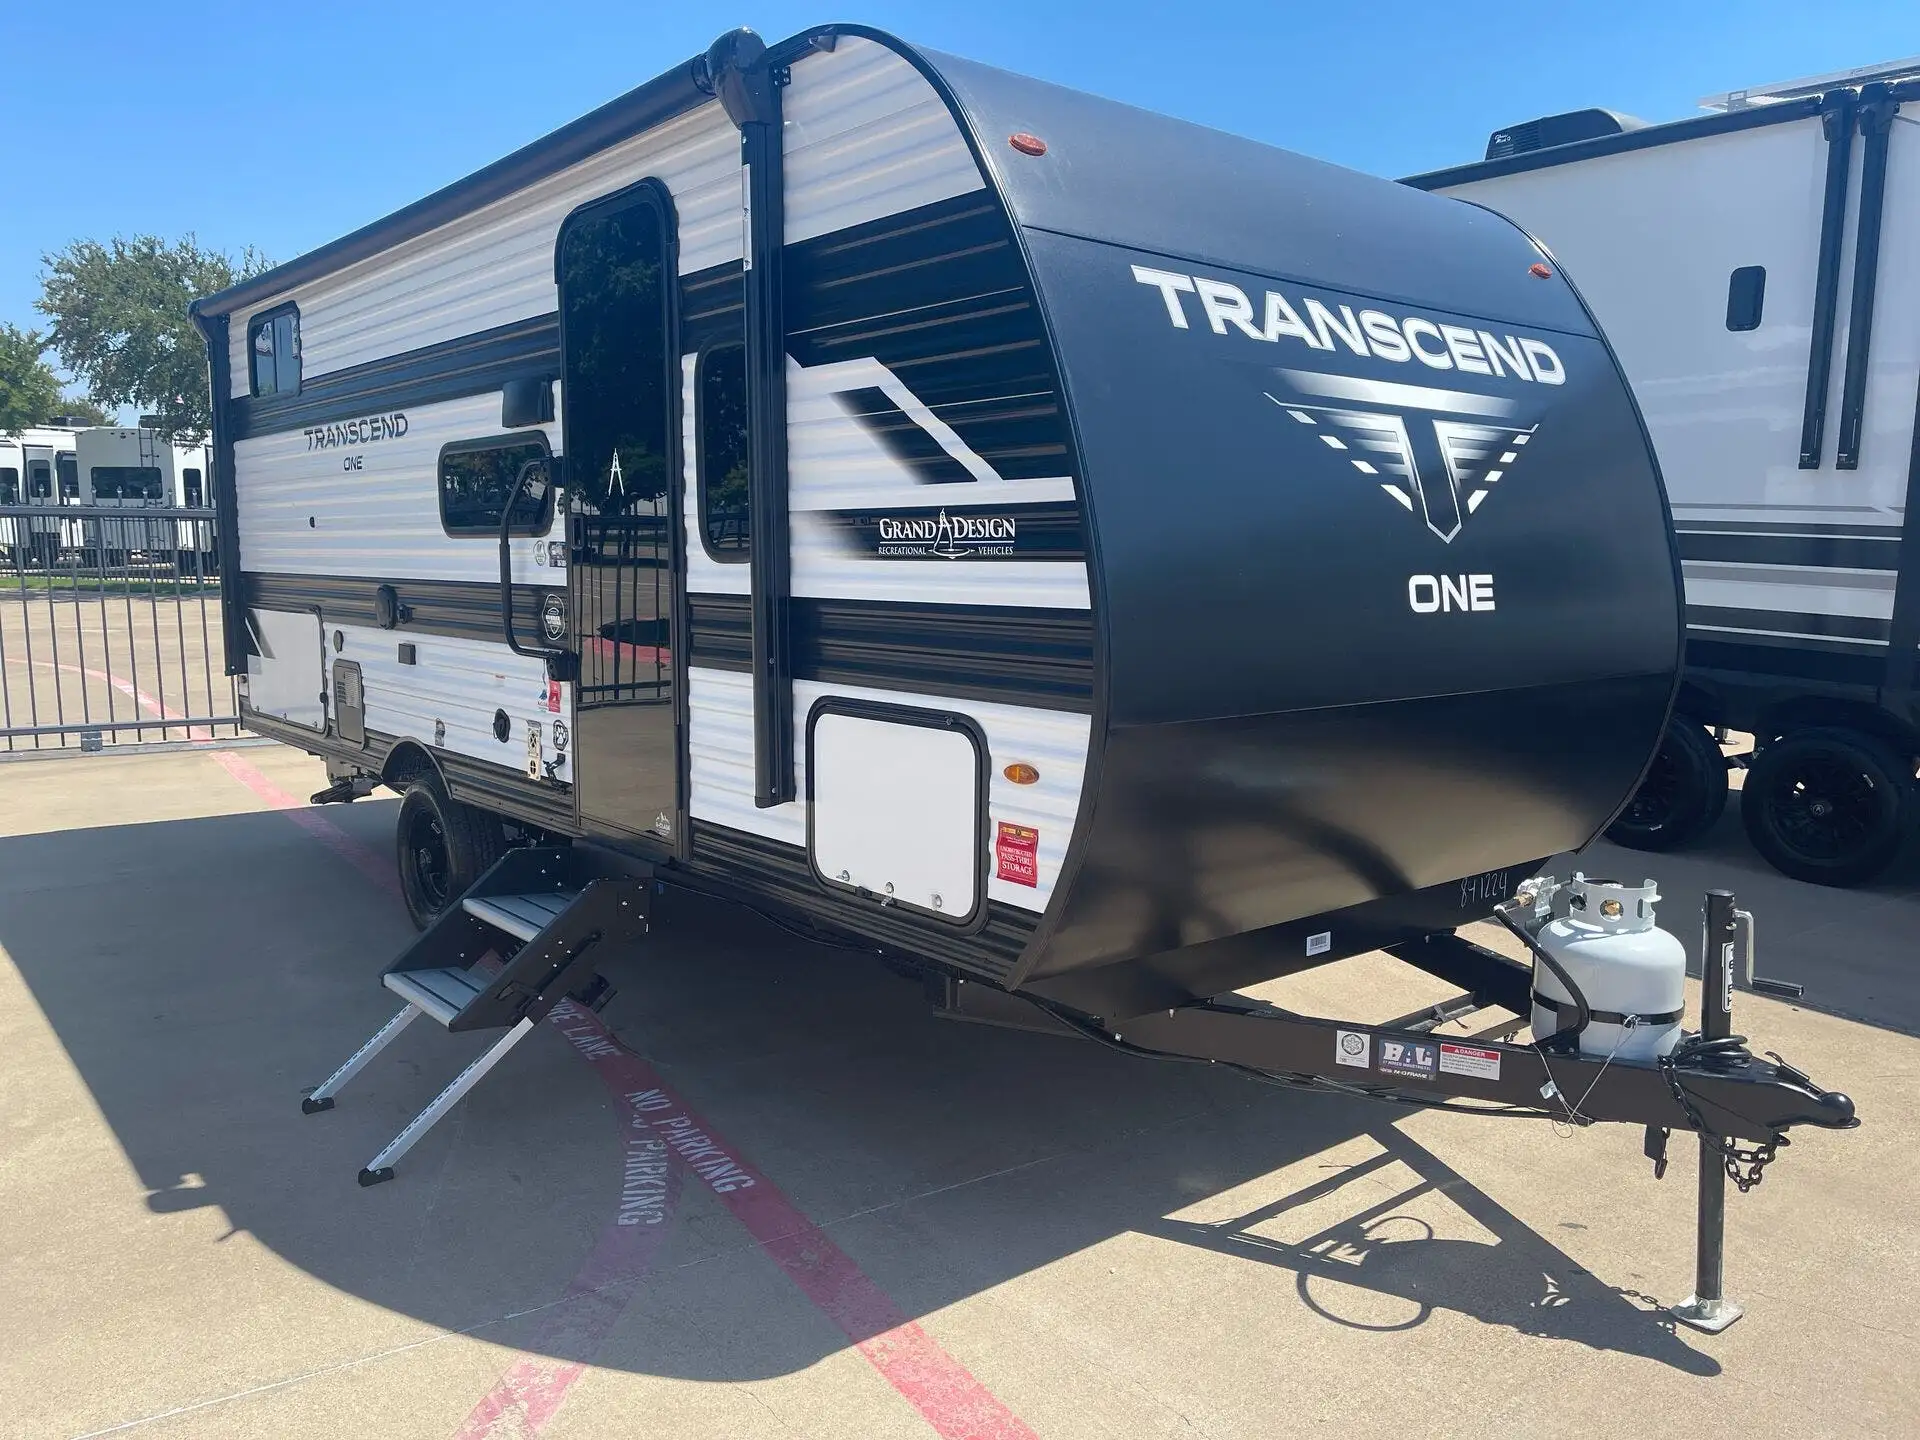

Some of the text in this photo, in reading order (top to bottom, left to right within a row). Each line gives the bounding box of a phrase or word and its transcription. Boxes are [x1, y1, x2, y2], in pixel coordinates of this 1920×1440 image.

[1130, 264, 1566, 386] TRANSCEND
[303, 413, 408, 451] TRANSCEND
[343, 455, 363, 471] ONE
[879, 516, 1016, 540] GRAND DESIGN
[878, 546, 1014, 555] RECREATIONAL VEHICLES
[1408, 573, 1496, 614] ONE
[1002, 861, 1033, 876] STORAGE
[1459, 1048, 1486, 1058] DANGER
[562, 1026, 622, 1061] LANE
[624, 1088, 672, 1112] NO
[652, 1115, 756, 1194] PARKING
[618, 1139, 669, 1227] PARKING
